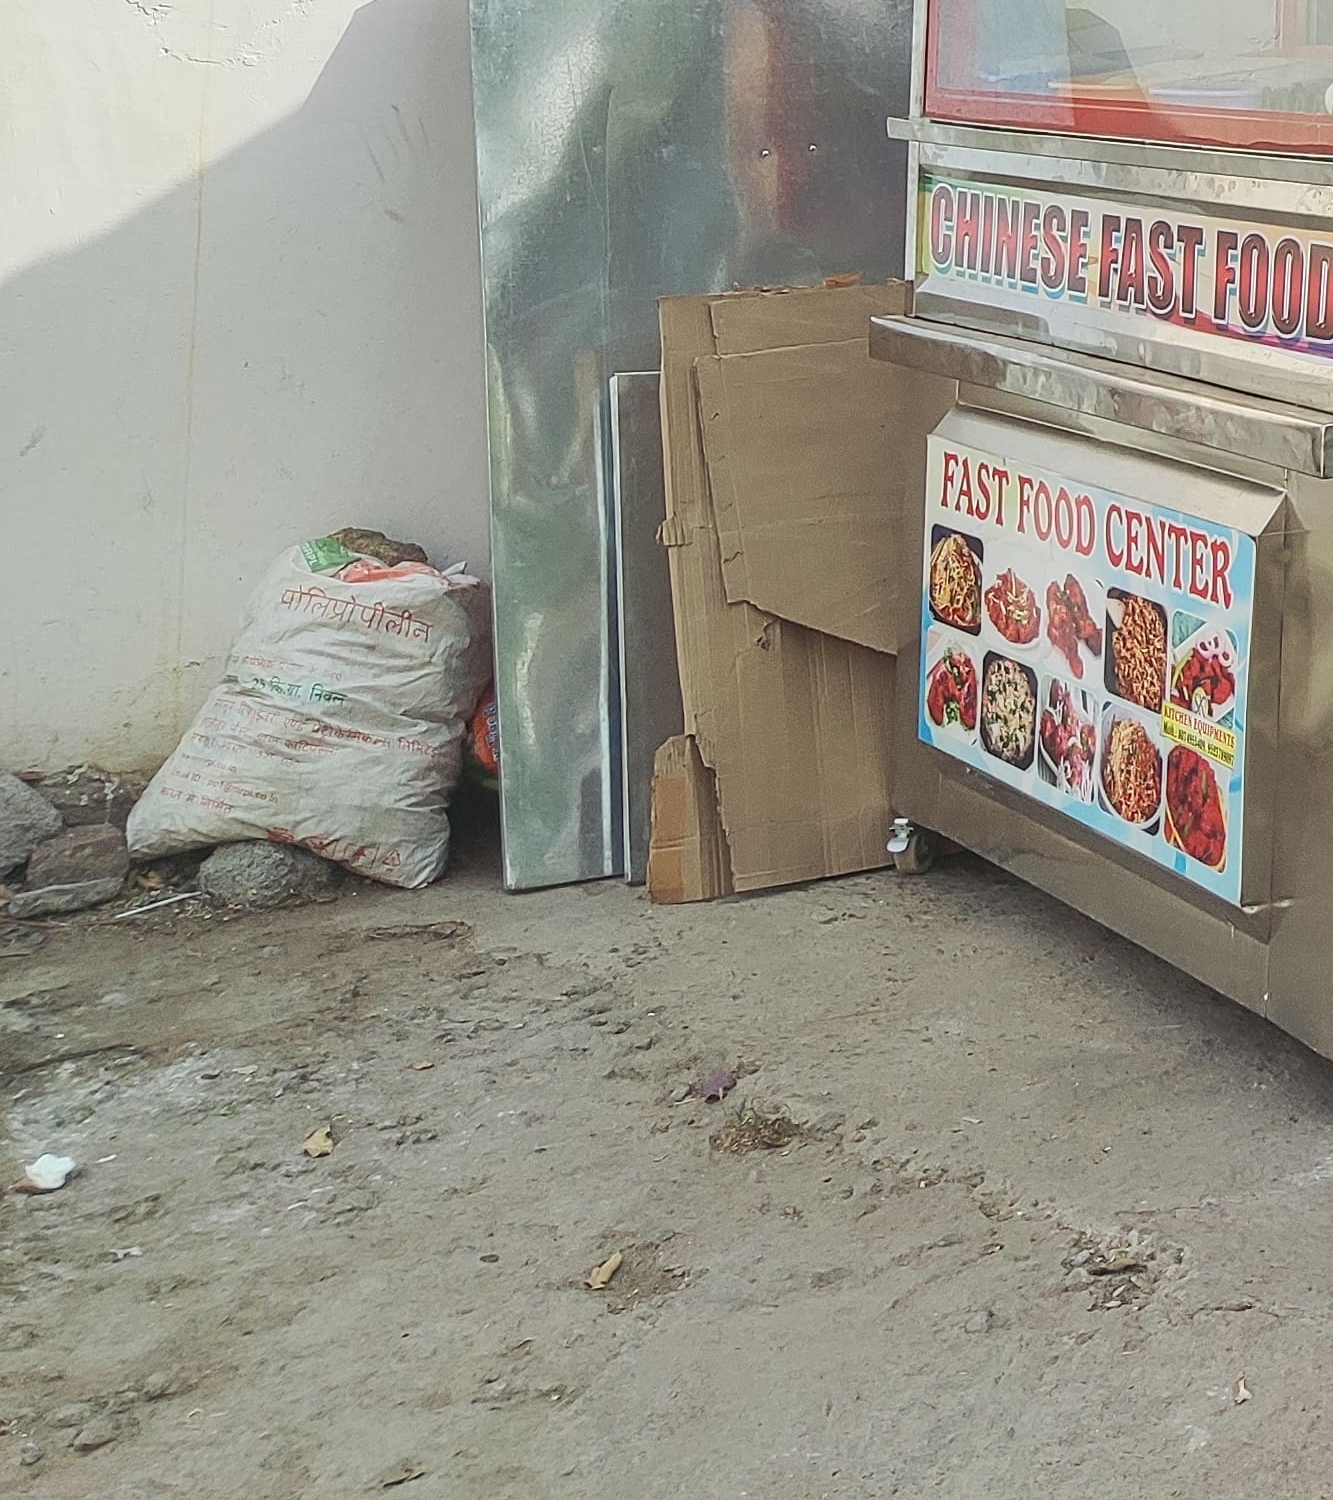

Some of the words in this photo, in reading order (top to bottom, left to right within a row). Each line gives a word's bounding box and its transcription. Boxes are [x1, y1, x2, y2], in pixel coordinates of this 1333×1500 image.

[930, 184, 1091, 298] CHINESE
[1098, 211, 1204, 320] FAST
[940, 451, 1009, 527] FAST
[1017, 475, 1096, 557] FOOD
[1105, 503, 1233, 608] CENTER
[1164, 705, 1192, 727] KITCHEN
[1194, 717, 1234, 749] EQUIPMENTS
